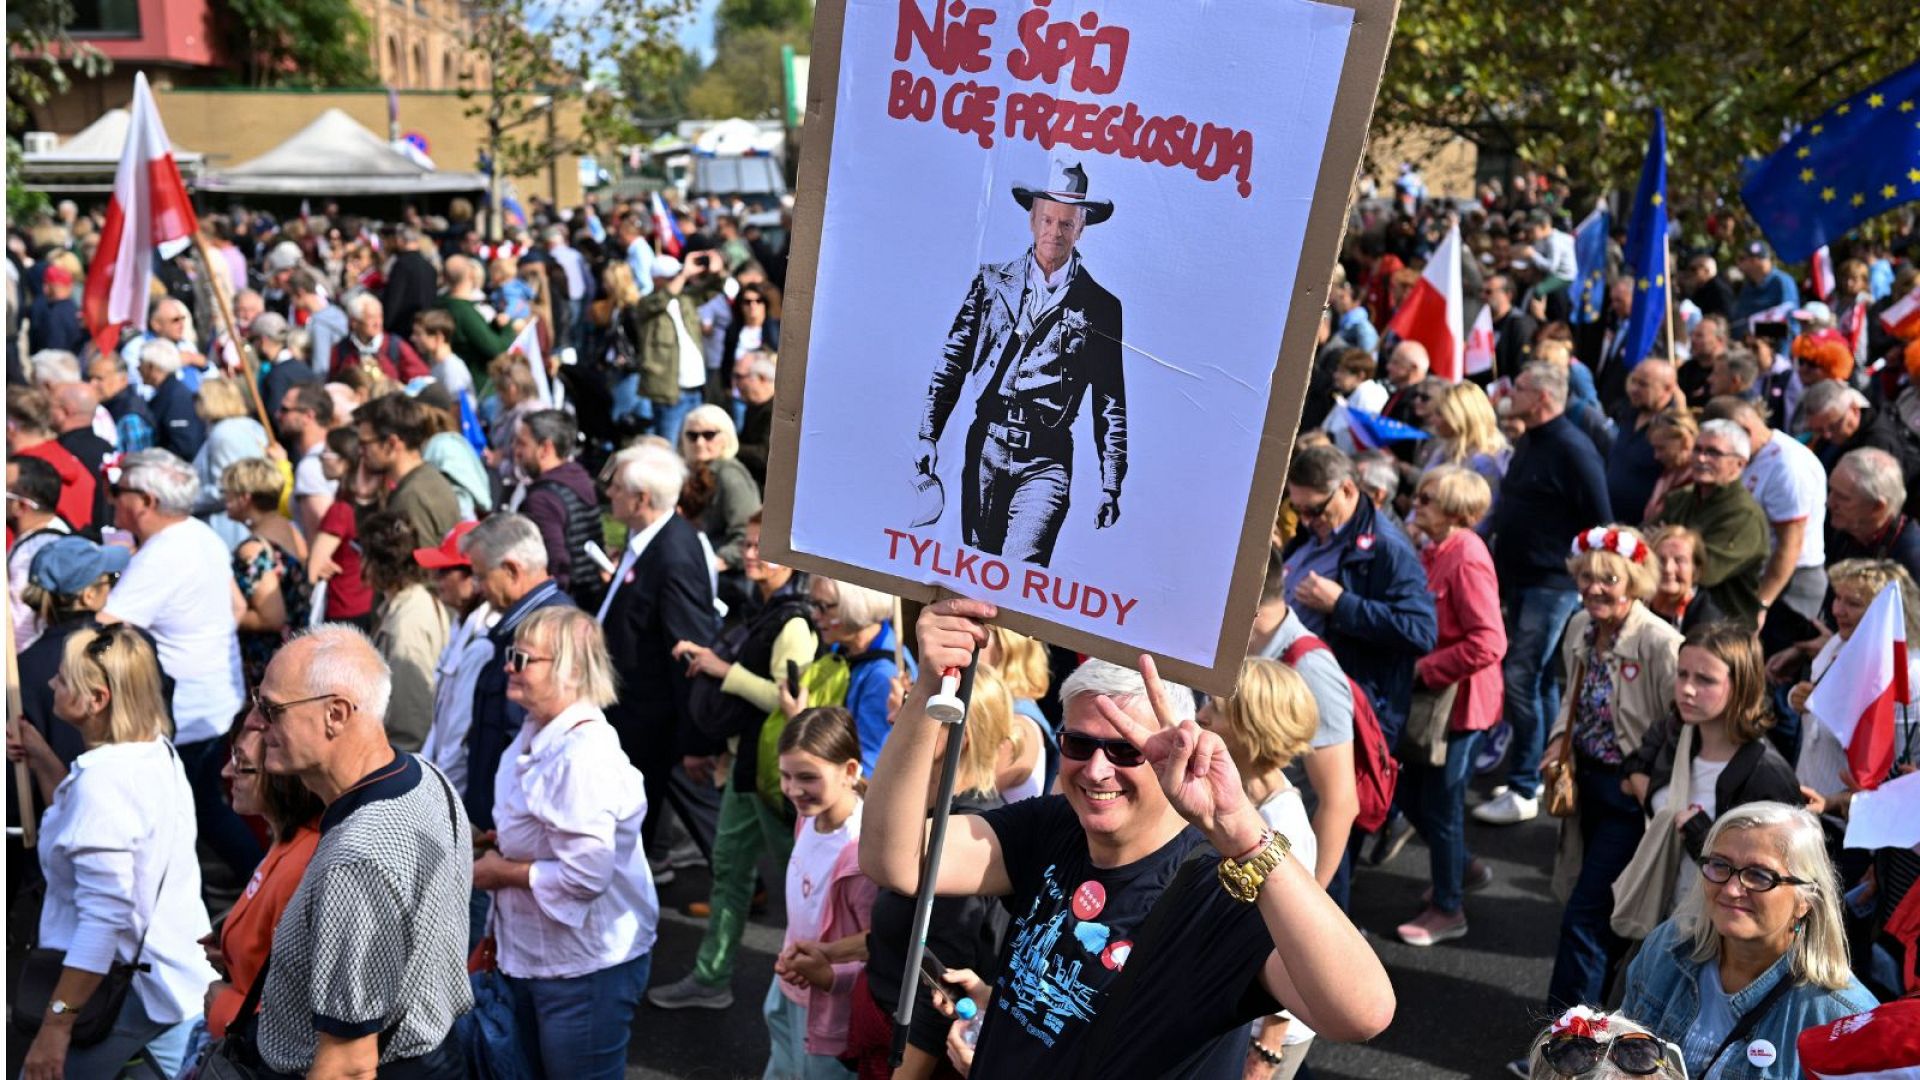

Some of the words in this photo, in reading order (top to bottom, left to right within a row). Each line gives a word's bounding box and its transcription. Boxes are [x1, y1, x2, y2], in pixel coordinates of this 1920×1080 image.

[888, 69, 936, 122] BO
[1004, 92, 1253, 198] PRZEGŁOSUJĄ
[883, 528, 1010, 591] TYLKO
[1022, 569, 1139, 626] RUDY
